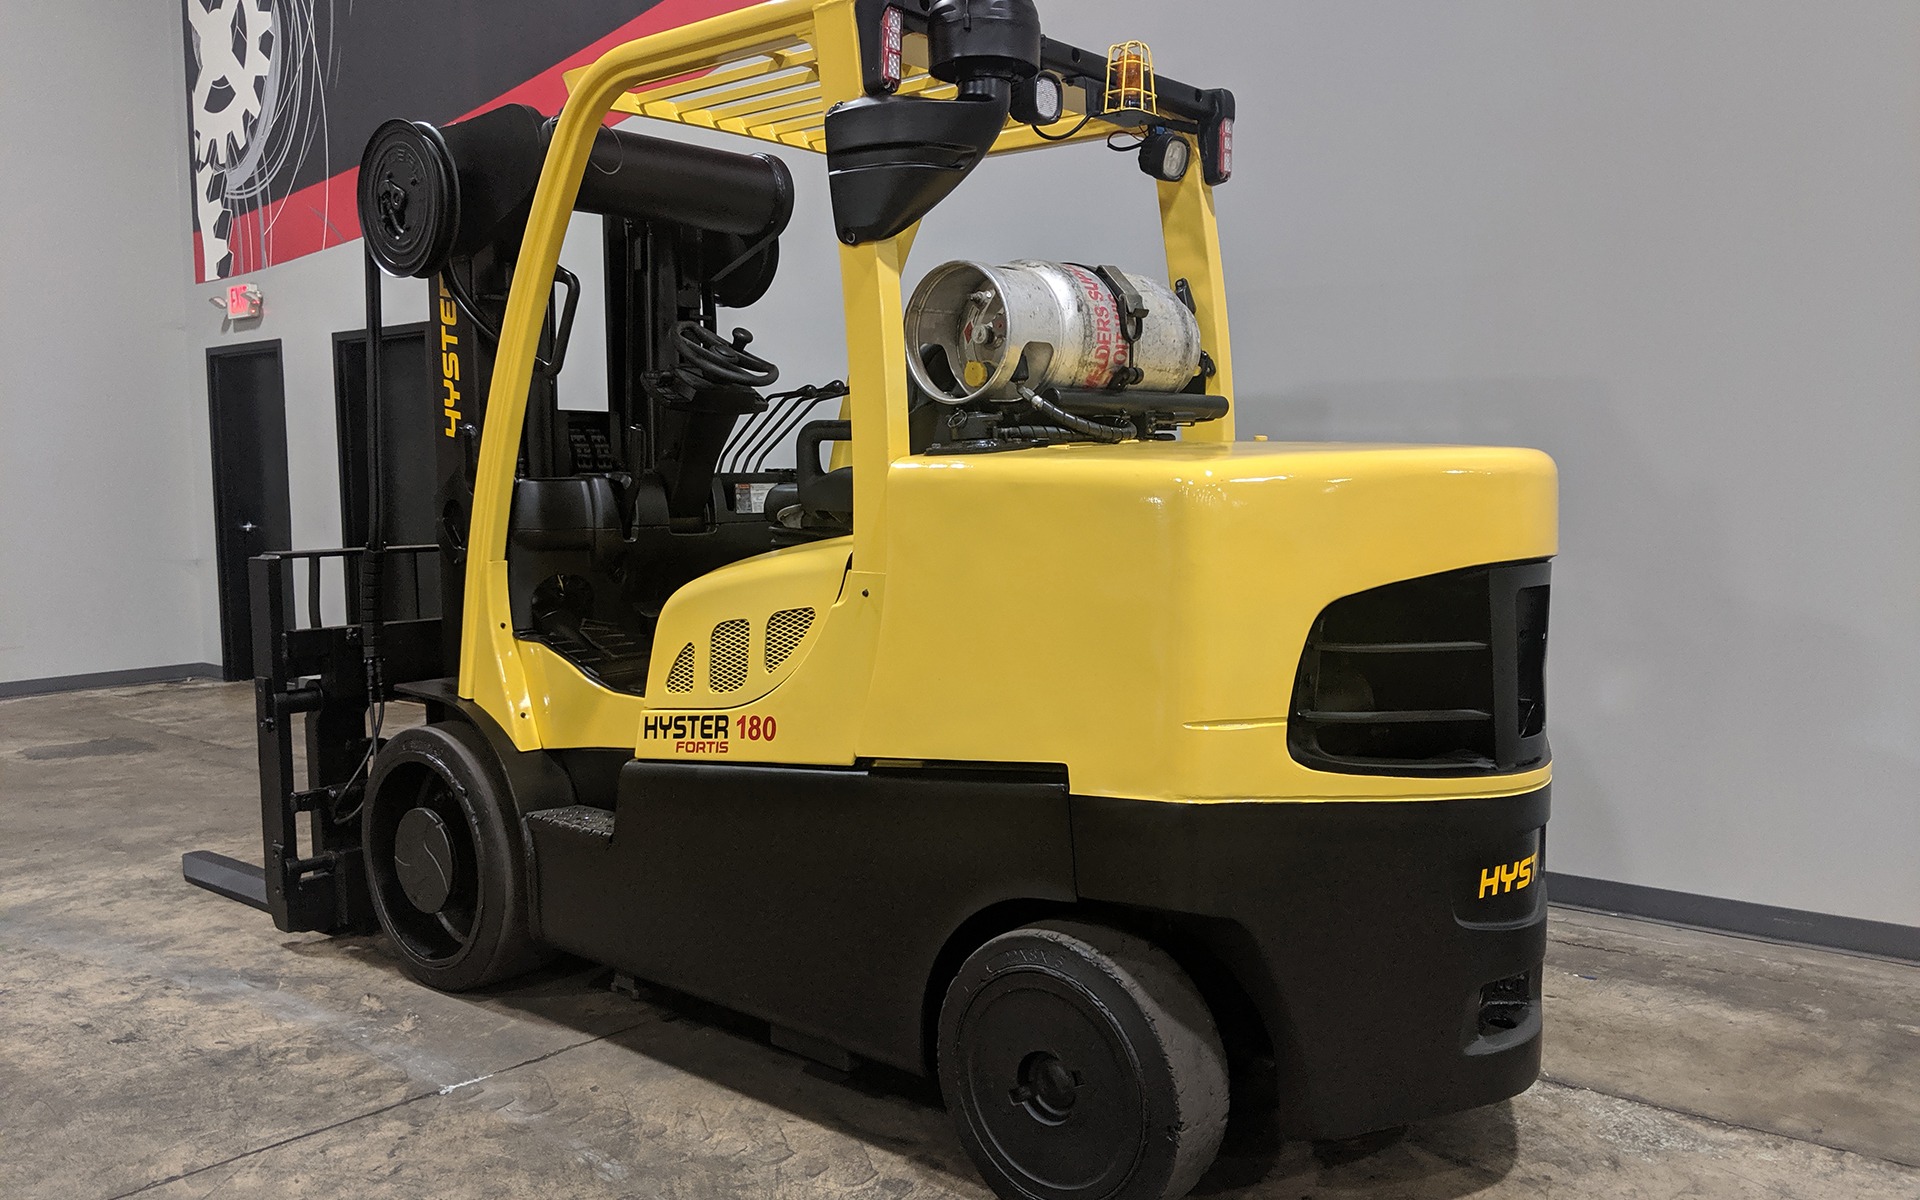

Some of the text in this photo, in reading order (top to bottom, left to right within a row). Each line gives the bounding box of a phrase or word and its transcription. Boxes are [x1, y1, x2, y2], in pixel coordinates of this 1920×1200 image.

[644, 714, 777, 742] HYSTER 180
[675, 741, 729, 753] FORTIS
